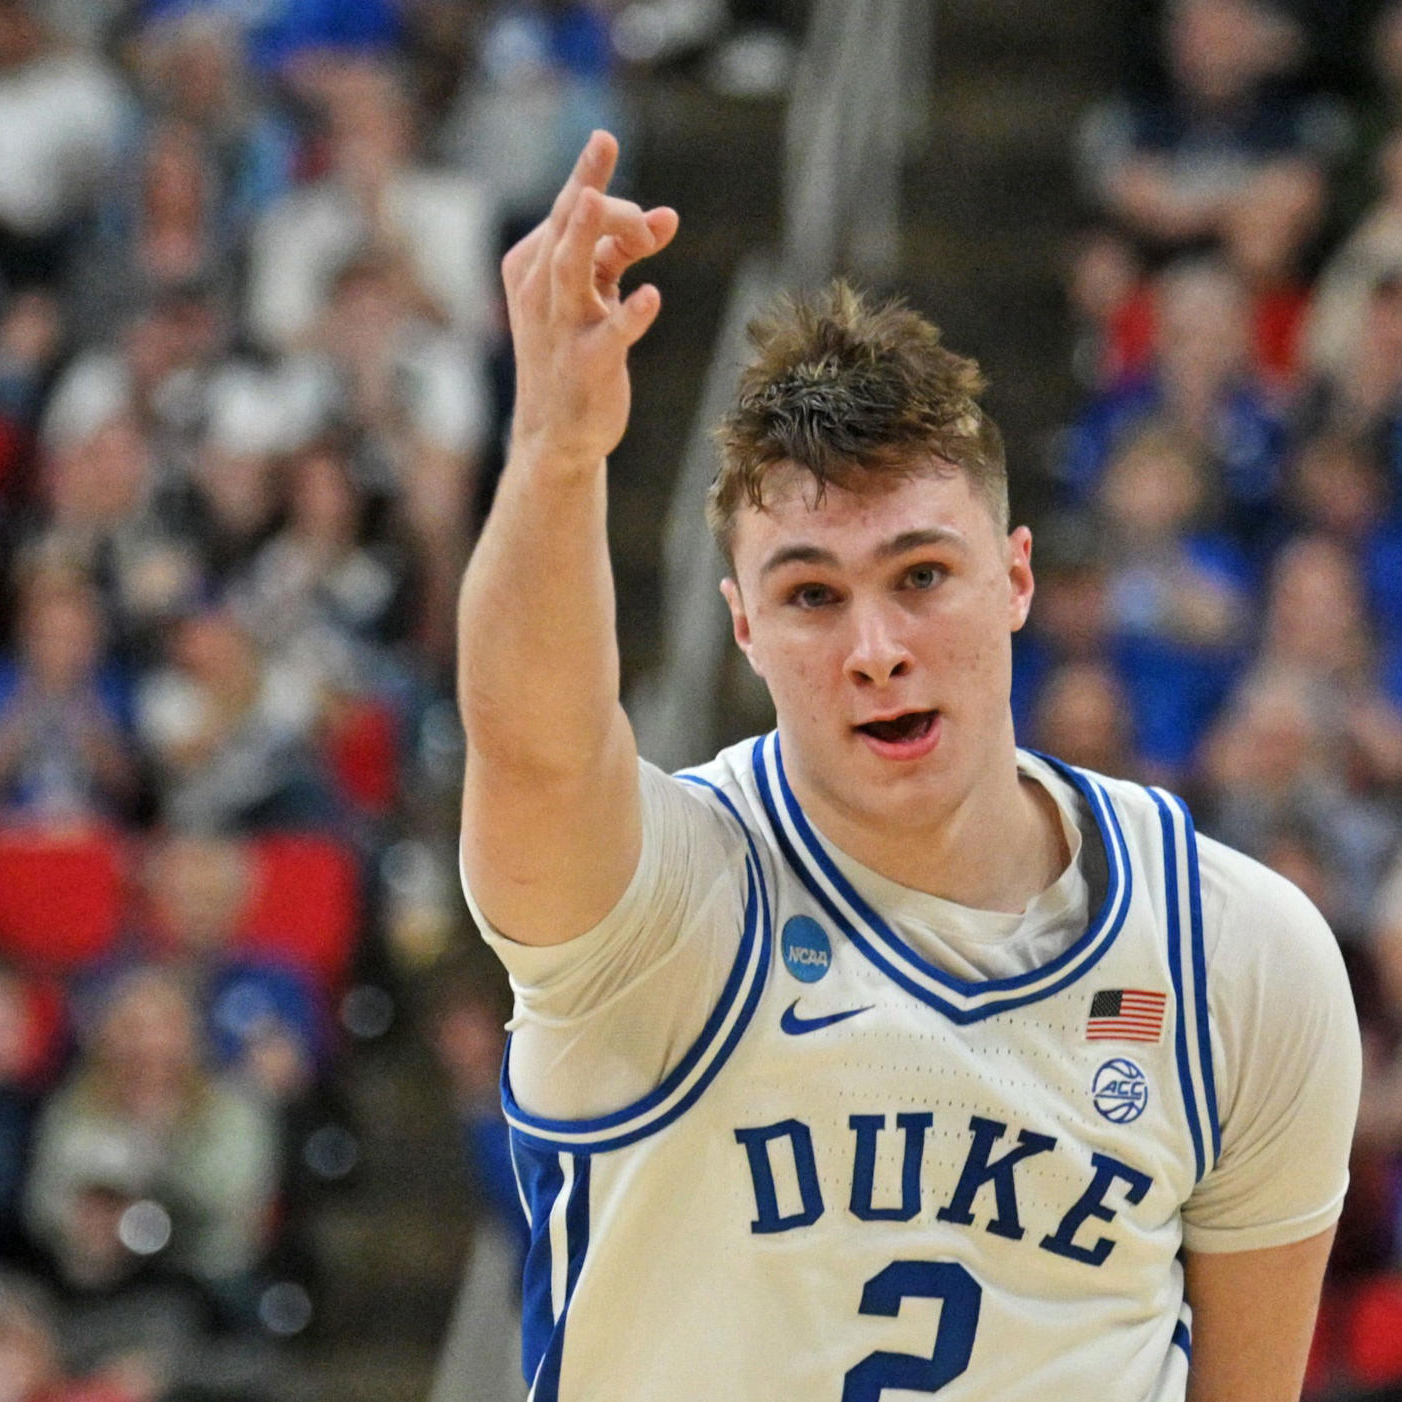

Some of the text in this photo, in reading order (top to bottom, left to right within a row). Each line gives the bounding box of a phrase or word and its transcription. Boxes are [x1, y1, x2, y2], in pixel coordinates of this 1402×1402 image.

[787, 945, 829, 968] NCAA
[1099, 1080, 1146, 1097] ACC
[734, 1111, 1153, 1267] DUKE
